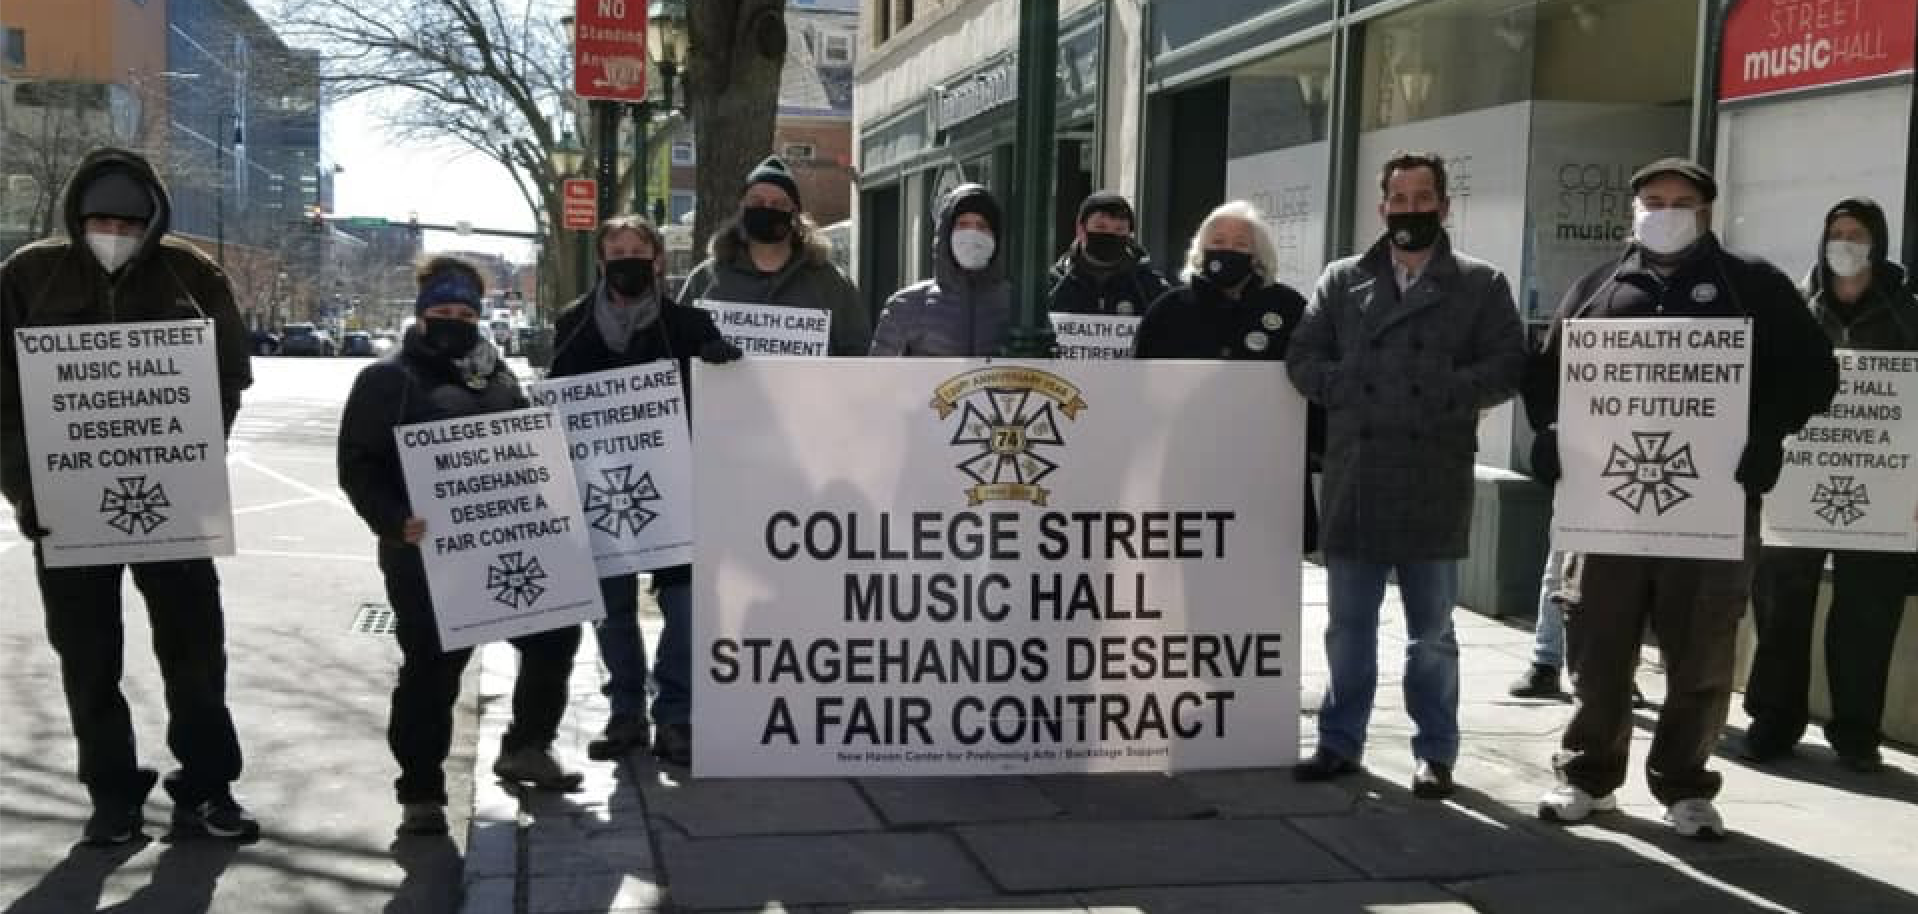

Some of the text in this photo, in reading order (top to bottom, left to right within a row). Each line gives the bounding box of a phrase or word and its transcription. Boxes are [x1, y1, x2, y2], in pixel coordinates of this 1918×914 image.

[598, 0, 625, 18] NO
[580, 24, 643, 47] Standing
[1558, 163, 1634, 190] COLL
[1556, 220, 1626, 242] music
[723, 310, 781, 328] HEALTH
[785, 315, 827, 332] CARE
[1058, 322, 1136, 336] HEALTH CA
[23, 326, 205, 354] COLLEGE STREET
[1567, 330, 1745, 349] NO HEALTH CARE
[57, 357, 181, 382] MUSIC HALL
[1567, 363, 1745, 383] NO RETIREMENT
[52, 387, 191, 412] STAGEHANDS
[562, 378, 626, 403] HEALTH
[631, 371, 677, 391] CARE
[1853, 380, 1898, 396] HALL
[568, 397, 680, 432] RETIREMENT
[1589, 396, 1716, 417] NO FUTURE
[1824, 404, 1903, 420] EHANDS
[68, 416, 183, 440] DESERVE A
[404, 412, 553, 448] COLLEGE STREET
[996, 431, 1019, 447] 74
[1879, 429, 1891, 444] A
[592, 430, 665, 456] FUTURE
[47, 443, 209, 472] FAIR CONTRACT
[435, 442, 539, 470] MUSIC HALL
[1784, 451, 1911, 468] AIR CONTRACT
[434, 466, 550, 499] STAGEHANDS
[451, 494, 549, 524] DESERVE A
[435, 516, 571, 555] FAIR CONTRACT
[765, 511, 1235, 562] COLLEGE STREET
[844, 573, 1162, 623] MUSIC HALL
[709, 633, 1282, 684] STAGEHANDS DESERVE
[760, 691, 1235, 745] A FAIR CONTRACT
[837, 750, 862, 761] New
[865, 750, 901, 761] Haven
[905, 750, 944, 761] Center
[947, 750, 963, 761] for
[1033, 749, 1057, 760] Arts
[1066, 747, 1123, 760] Backstage
[1125, 745, 1170, 758] Support
